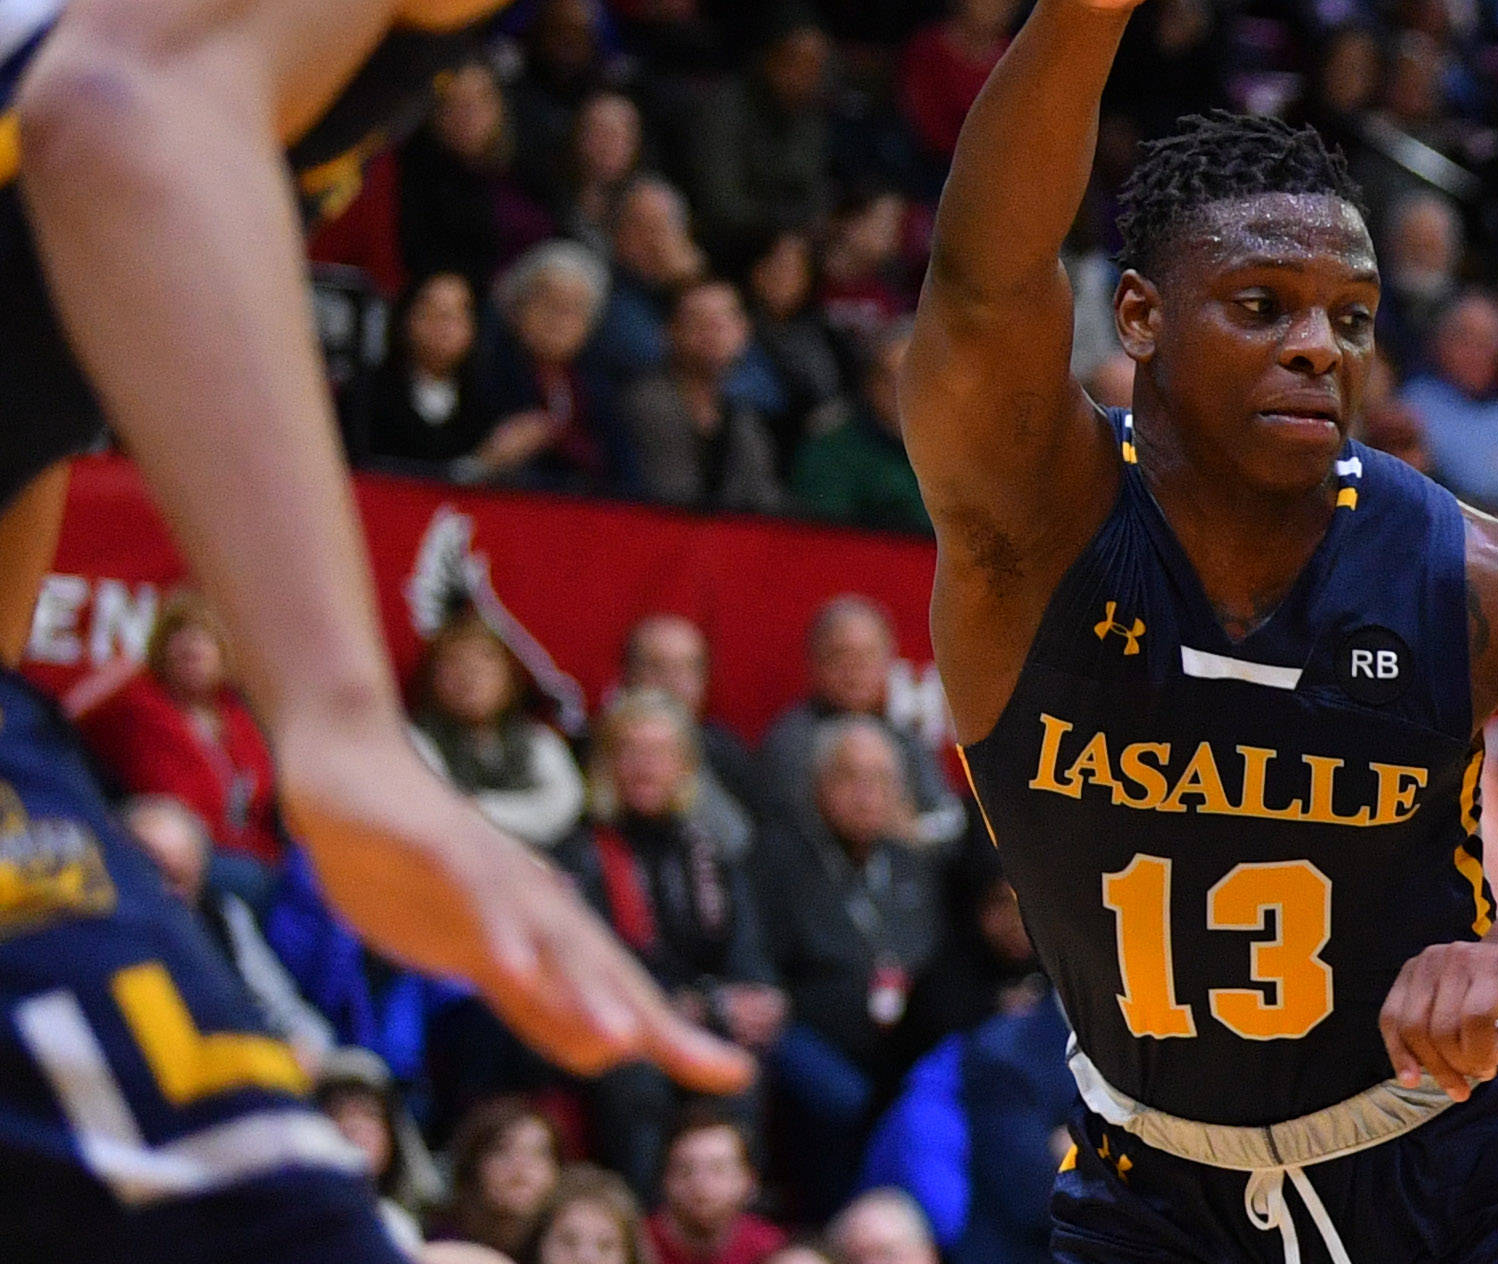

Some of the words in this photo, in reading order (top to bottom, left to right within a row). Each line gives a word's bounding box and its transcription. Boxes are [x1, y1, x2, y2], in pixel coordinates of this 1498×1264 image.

[1351, 649, 1399, 679] RB
[1029, 713, 1428, 827] LASALLE
[1102, 853, 1334, 1041] 13
